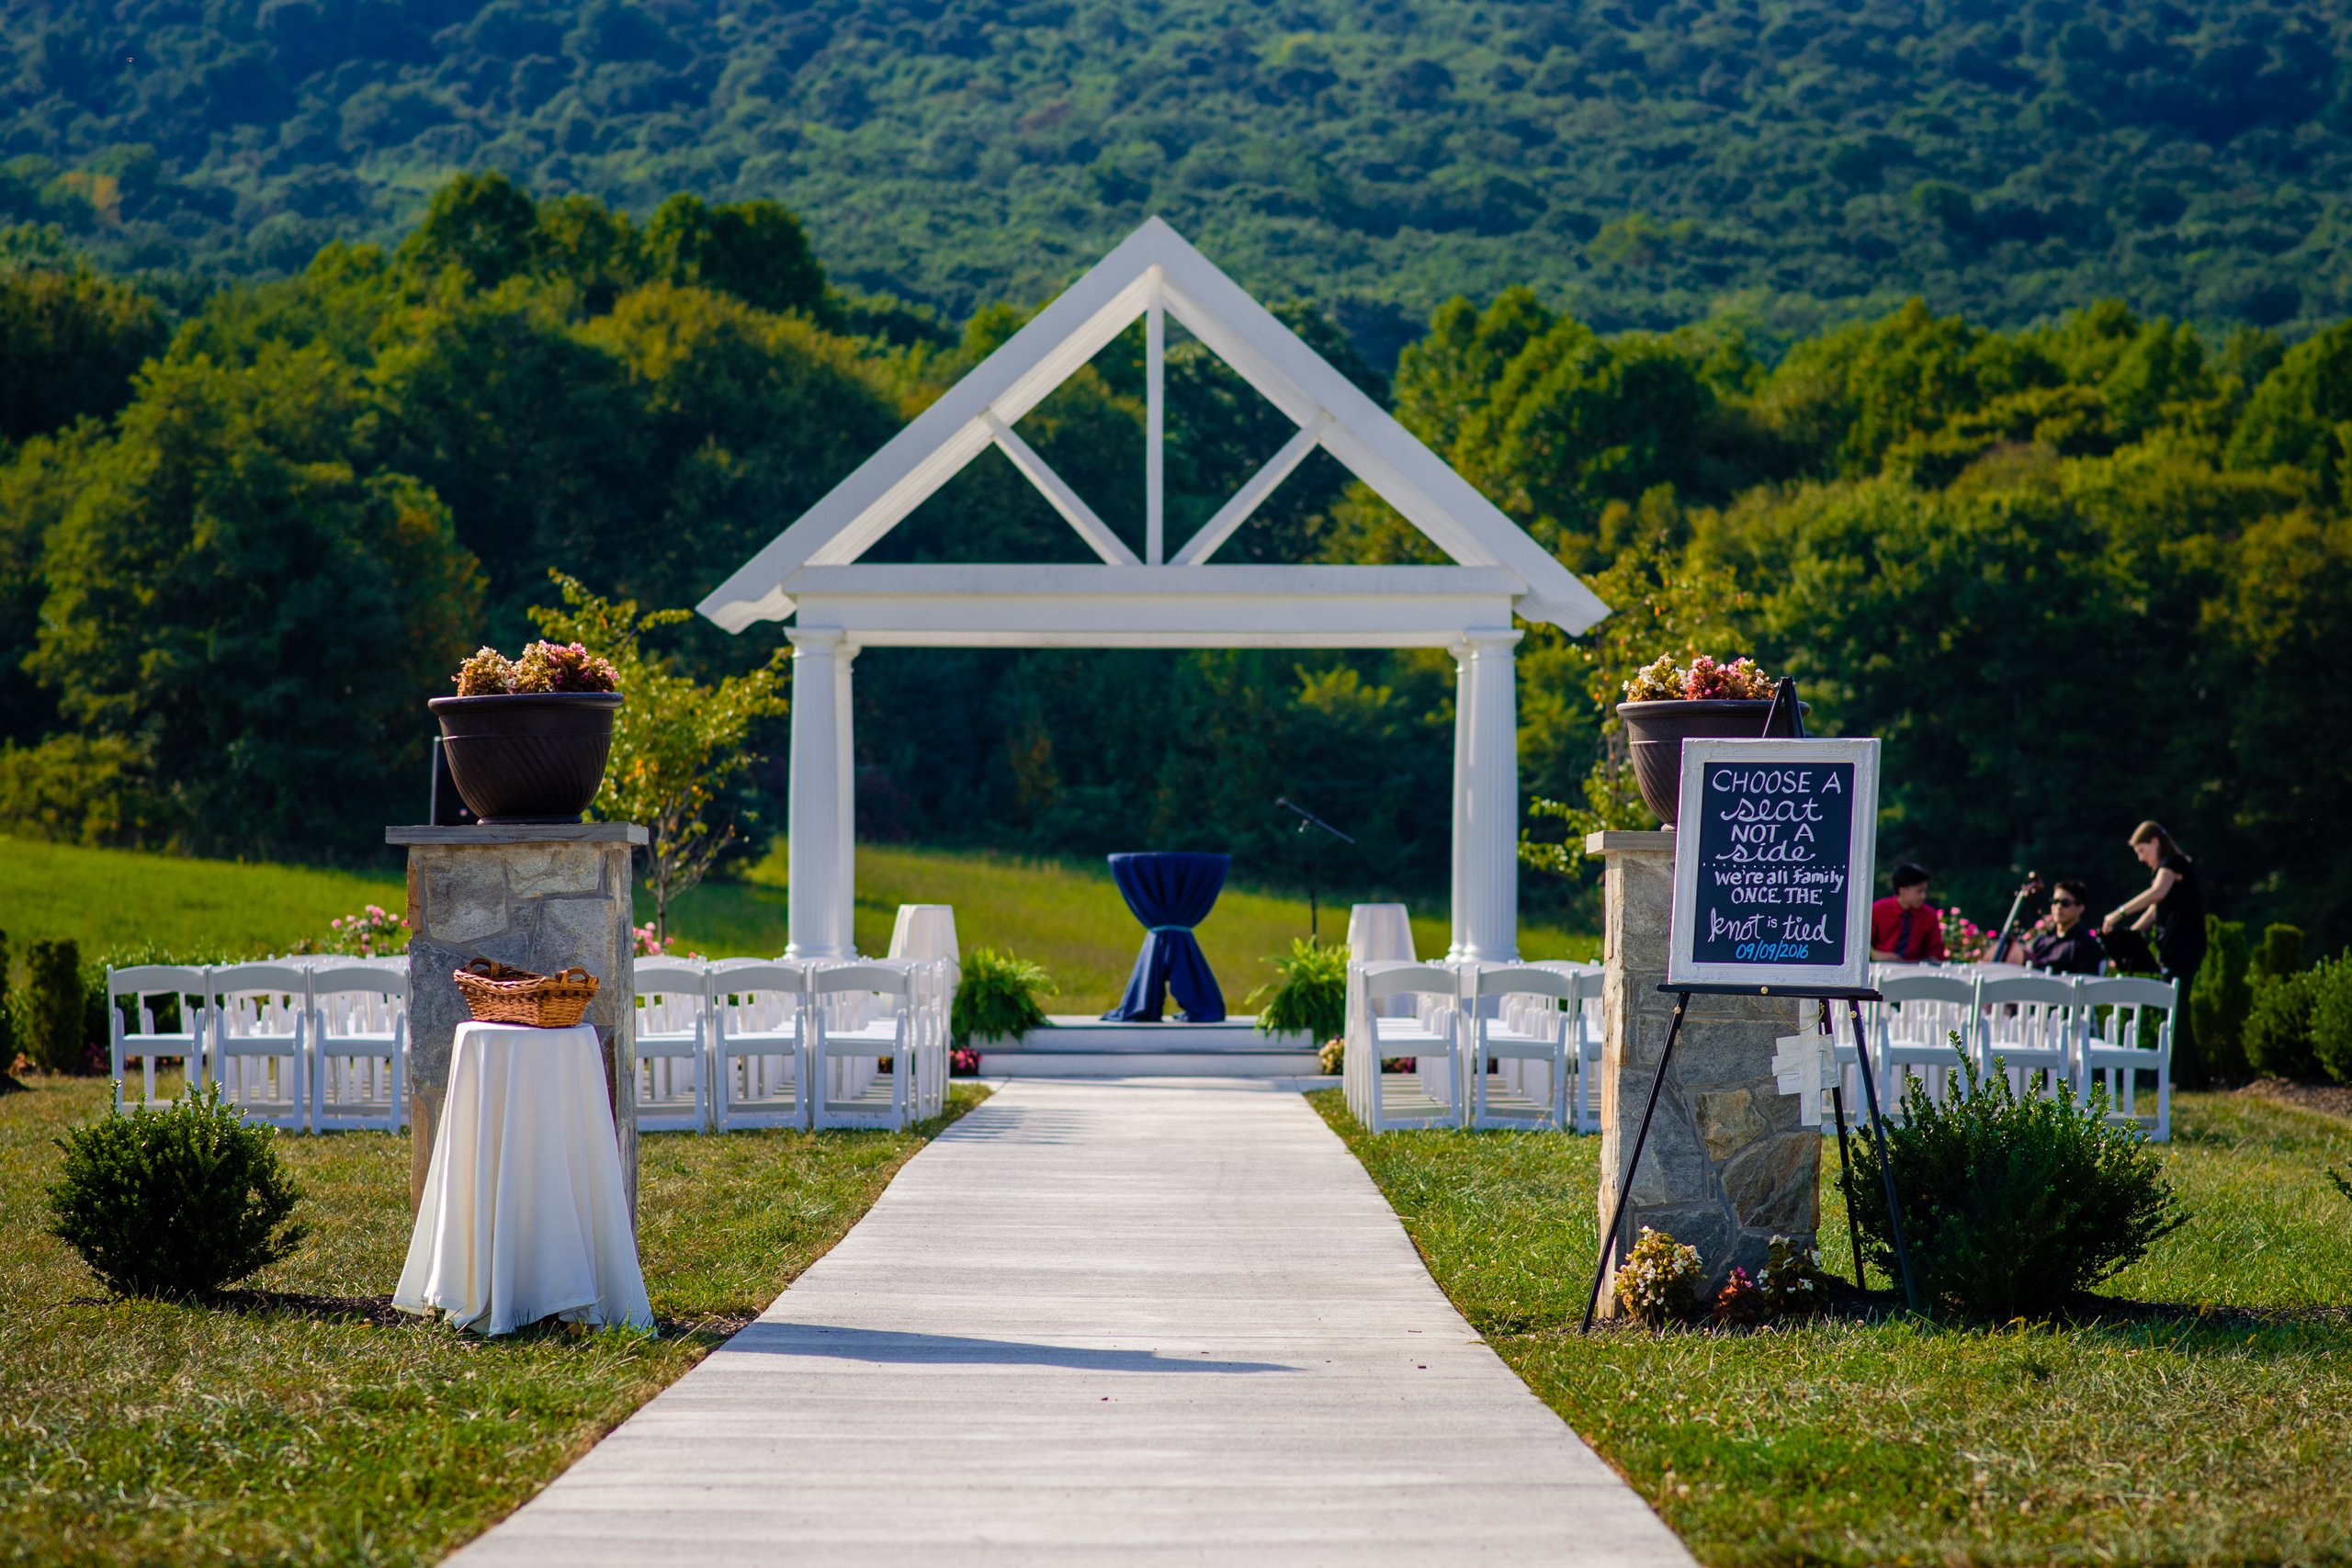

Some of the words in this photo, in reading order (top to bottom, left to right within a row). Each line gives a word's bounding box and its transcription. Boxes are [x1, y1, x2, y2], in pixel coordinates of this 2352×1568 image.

[1712, 769, 1813, 794] CHOOSE
[1821, 771, 1842, 795] A
[1719, 796, 1824, 823] seat
[1730, 823, 1781, 843] NOT
[1793, 822, 1815, 842] A
[1714, 840, 1816, 863] side
[1714, 869, 1763, 886] we're
[1766, 870, 1788, 885] all
[1792, 868, 1845, 894] family
[1731, 886, 1781, 905] ONCE
[1783, 886, 1824, 906] THE
[1707, 907, 1765, 942] knot
[1767, 916, 1778, 929] is
[1781, 913, 1835, 944] tied
[1735, 939, 1809, 962] 09/09/2016
